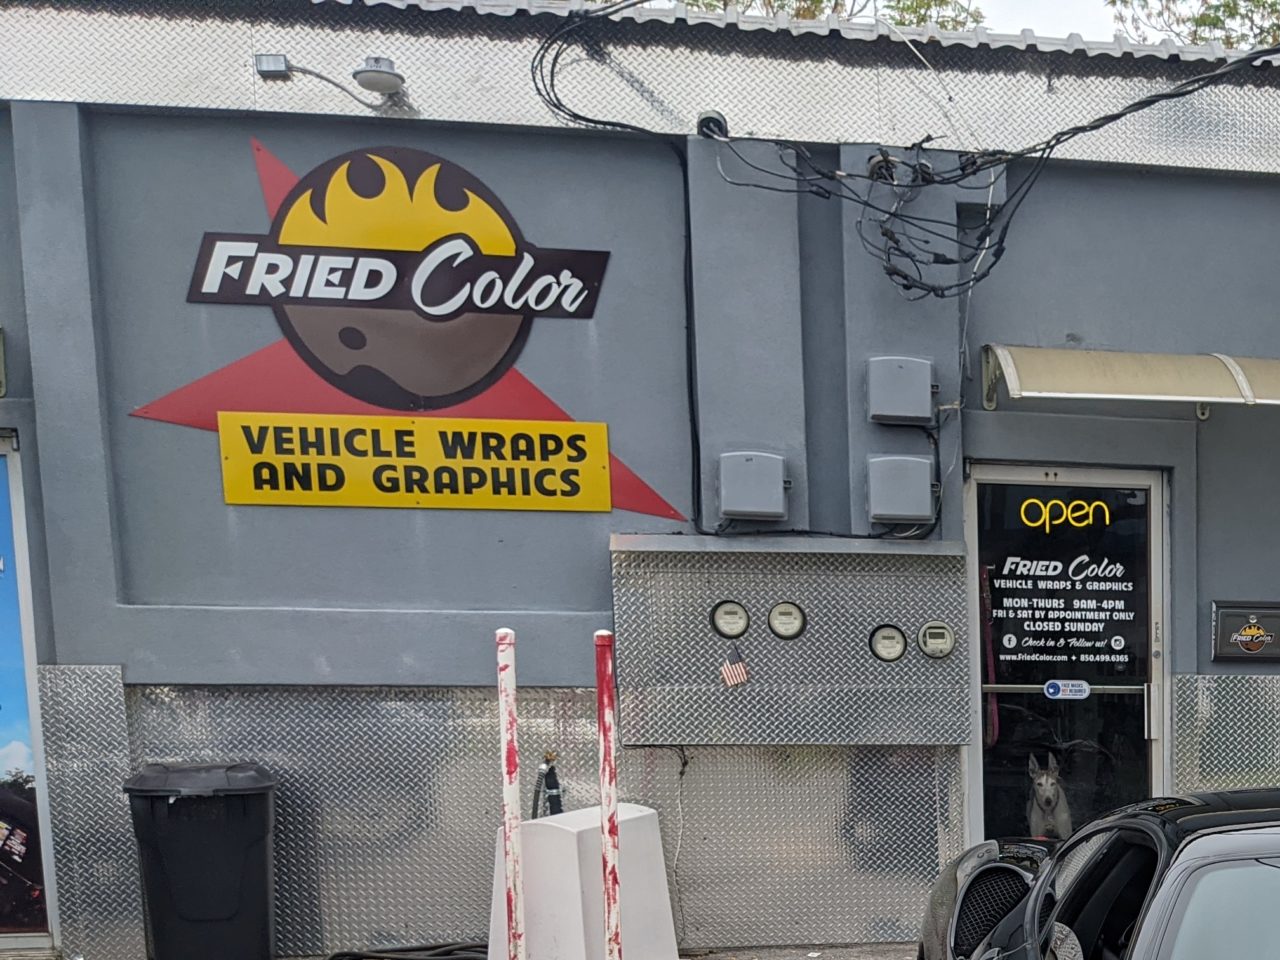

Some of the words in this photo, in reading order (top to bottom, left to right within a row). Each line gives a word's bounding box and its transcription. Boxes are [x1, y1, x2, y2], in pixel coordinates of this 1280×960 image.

[201, 241, 397, 301] FRIED
[411, 239, 589, 316] Color
[240, 425, 415, 459] VEHICLE
[438, 431, 587, 463] WRAPS
[253, 461, 346, 492] AND
[372, 464, 580, 497] GRAPHICS
[1020, 498, 1109, 534] open
[1002, 556, 1063, 576] FRIED
[1068, 554, 1125, 580] Color
[994, 579, 1033, 589] VEHICLE
[1037, 580, 1072, 590] WRAPS
[1075, 581, 1083, 590] &
[1086, 581, 1134, 591] GRAPHICS
[1003, 598, 1065, 609] MON-THURS
[1073, 599, 1125, 610] 9AM-4PM
[992, 609, 1006, 618] FRI
[1008, 610, 1015, 618] &
[1017, 610, 1033, 619] SAT
[1035, 610, 1046, 619] BY
[1048, 610, 1111, 620] APPOINTMENT
[1112, 612, 1135, 621] ONLY
[1024, 621, 1061, 631] CLOSED
[1064, 622, 1105, 632] SUNDAY
[1021, 637, 1045, 647] Check
[1046, 637, 1055, 647] in
[1067, 638, 1094, 647] Follow
[1253, 634, 1272, 642] Color
[999, 653, 1068, 662] www.FriedColor.com
[1080, 654, 1129, 662] 850.499.6365
